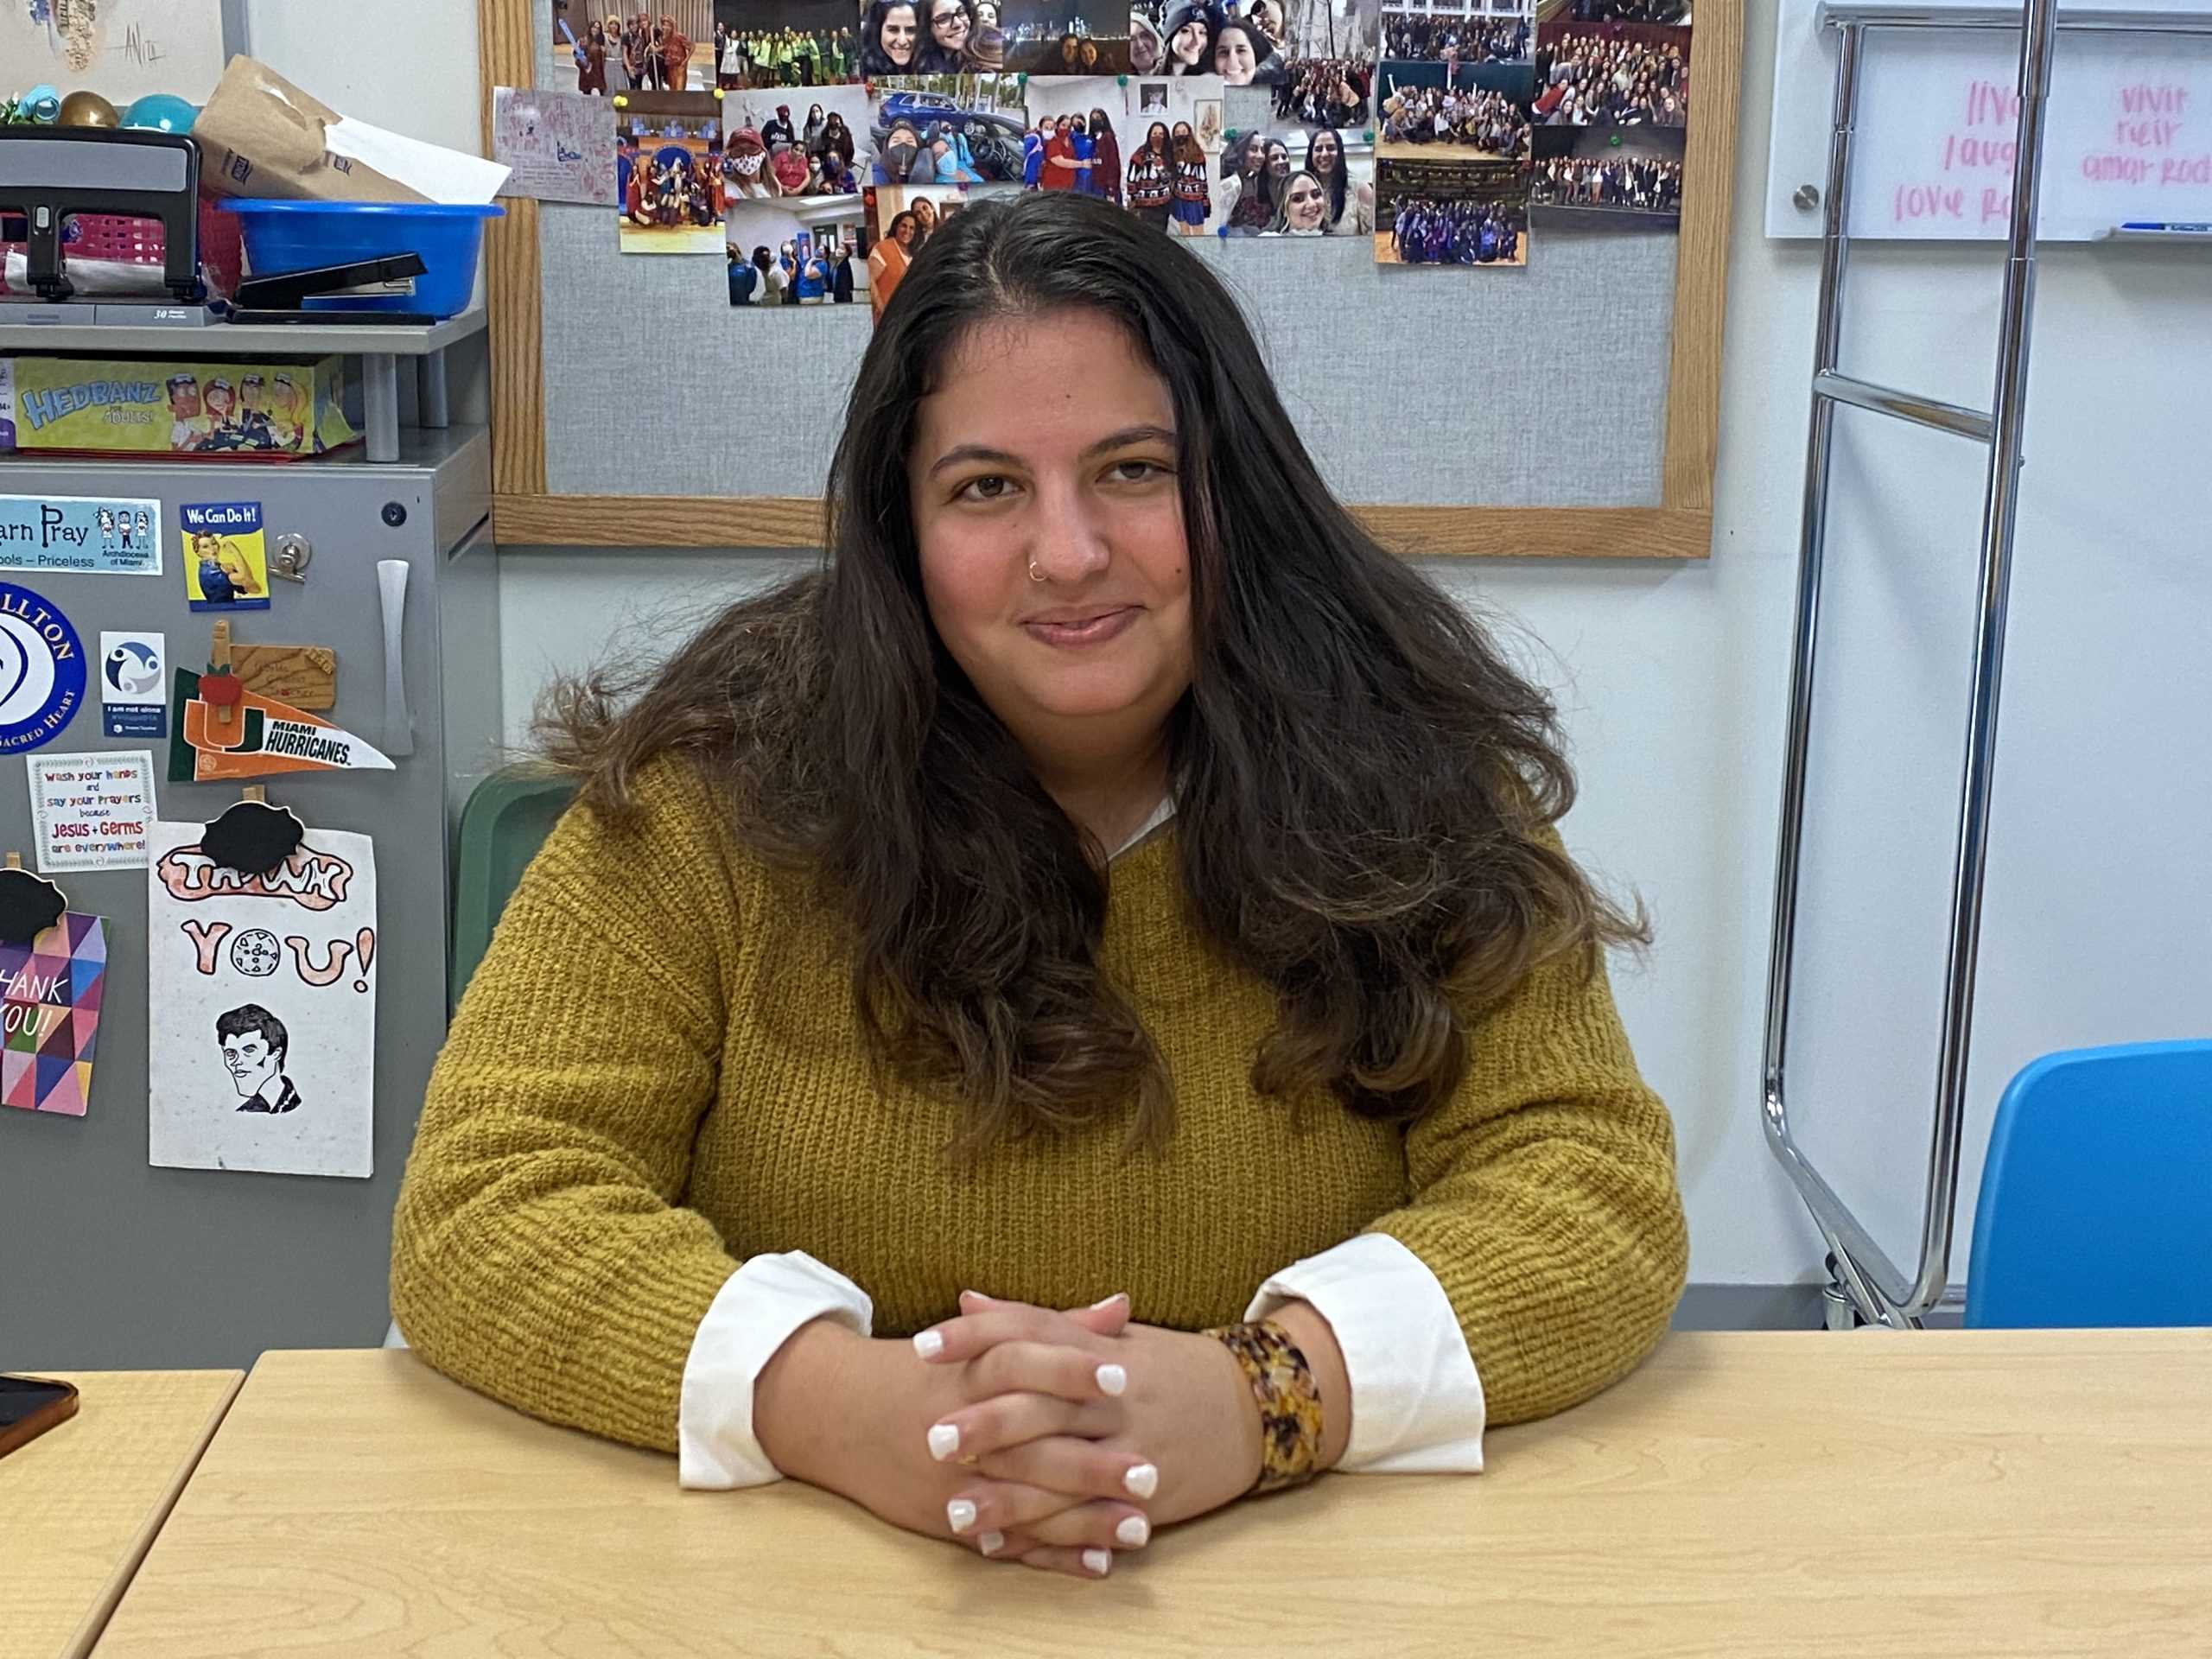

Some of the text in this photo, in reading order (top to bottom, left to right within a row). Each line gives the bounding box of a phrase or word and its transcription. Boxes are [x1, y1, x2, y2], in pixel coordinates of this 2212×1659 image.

[1943, 134, 2017, 175] laug
[1894, 183, 1963, 221] love
[21, 380, 162, 430] HEDBANZ
[186, 507, 257, 524] We Can Do It!
[41, 504, 89, 548] Pray
[38, 555, 95, 568] Priceless
[43, 690, 76, 729] HEART
[270, 721, 317, 737] MIAMI
[77, 771, 103, 782] your
[86, 782, 100, 791] and
[47, 798, 67, 808] say
[69, 797, 94, 807] your
[52, 823, 90, 839] Jesus
[99, 821, 143, 836] Germs
[52, 840, 146, 854] are everywhere!
